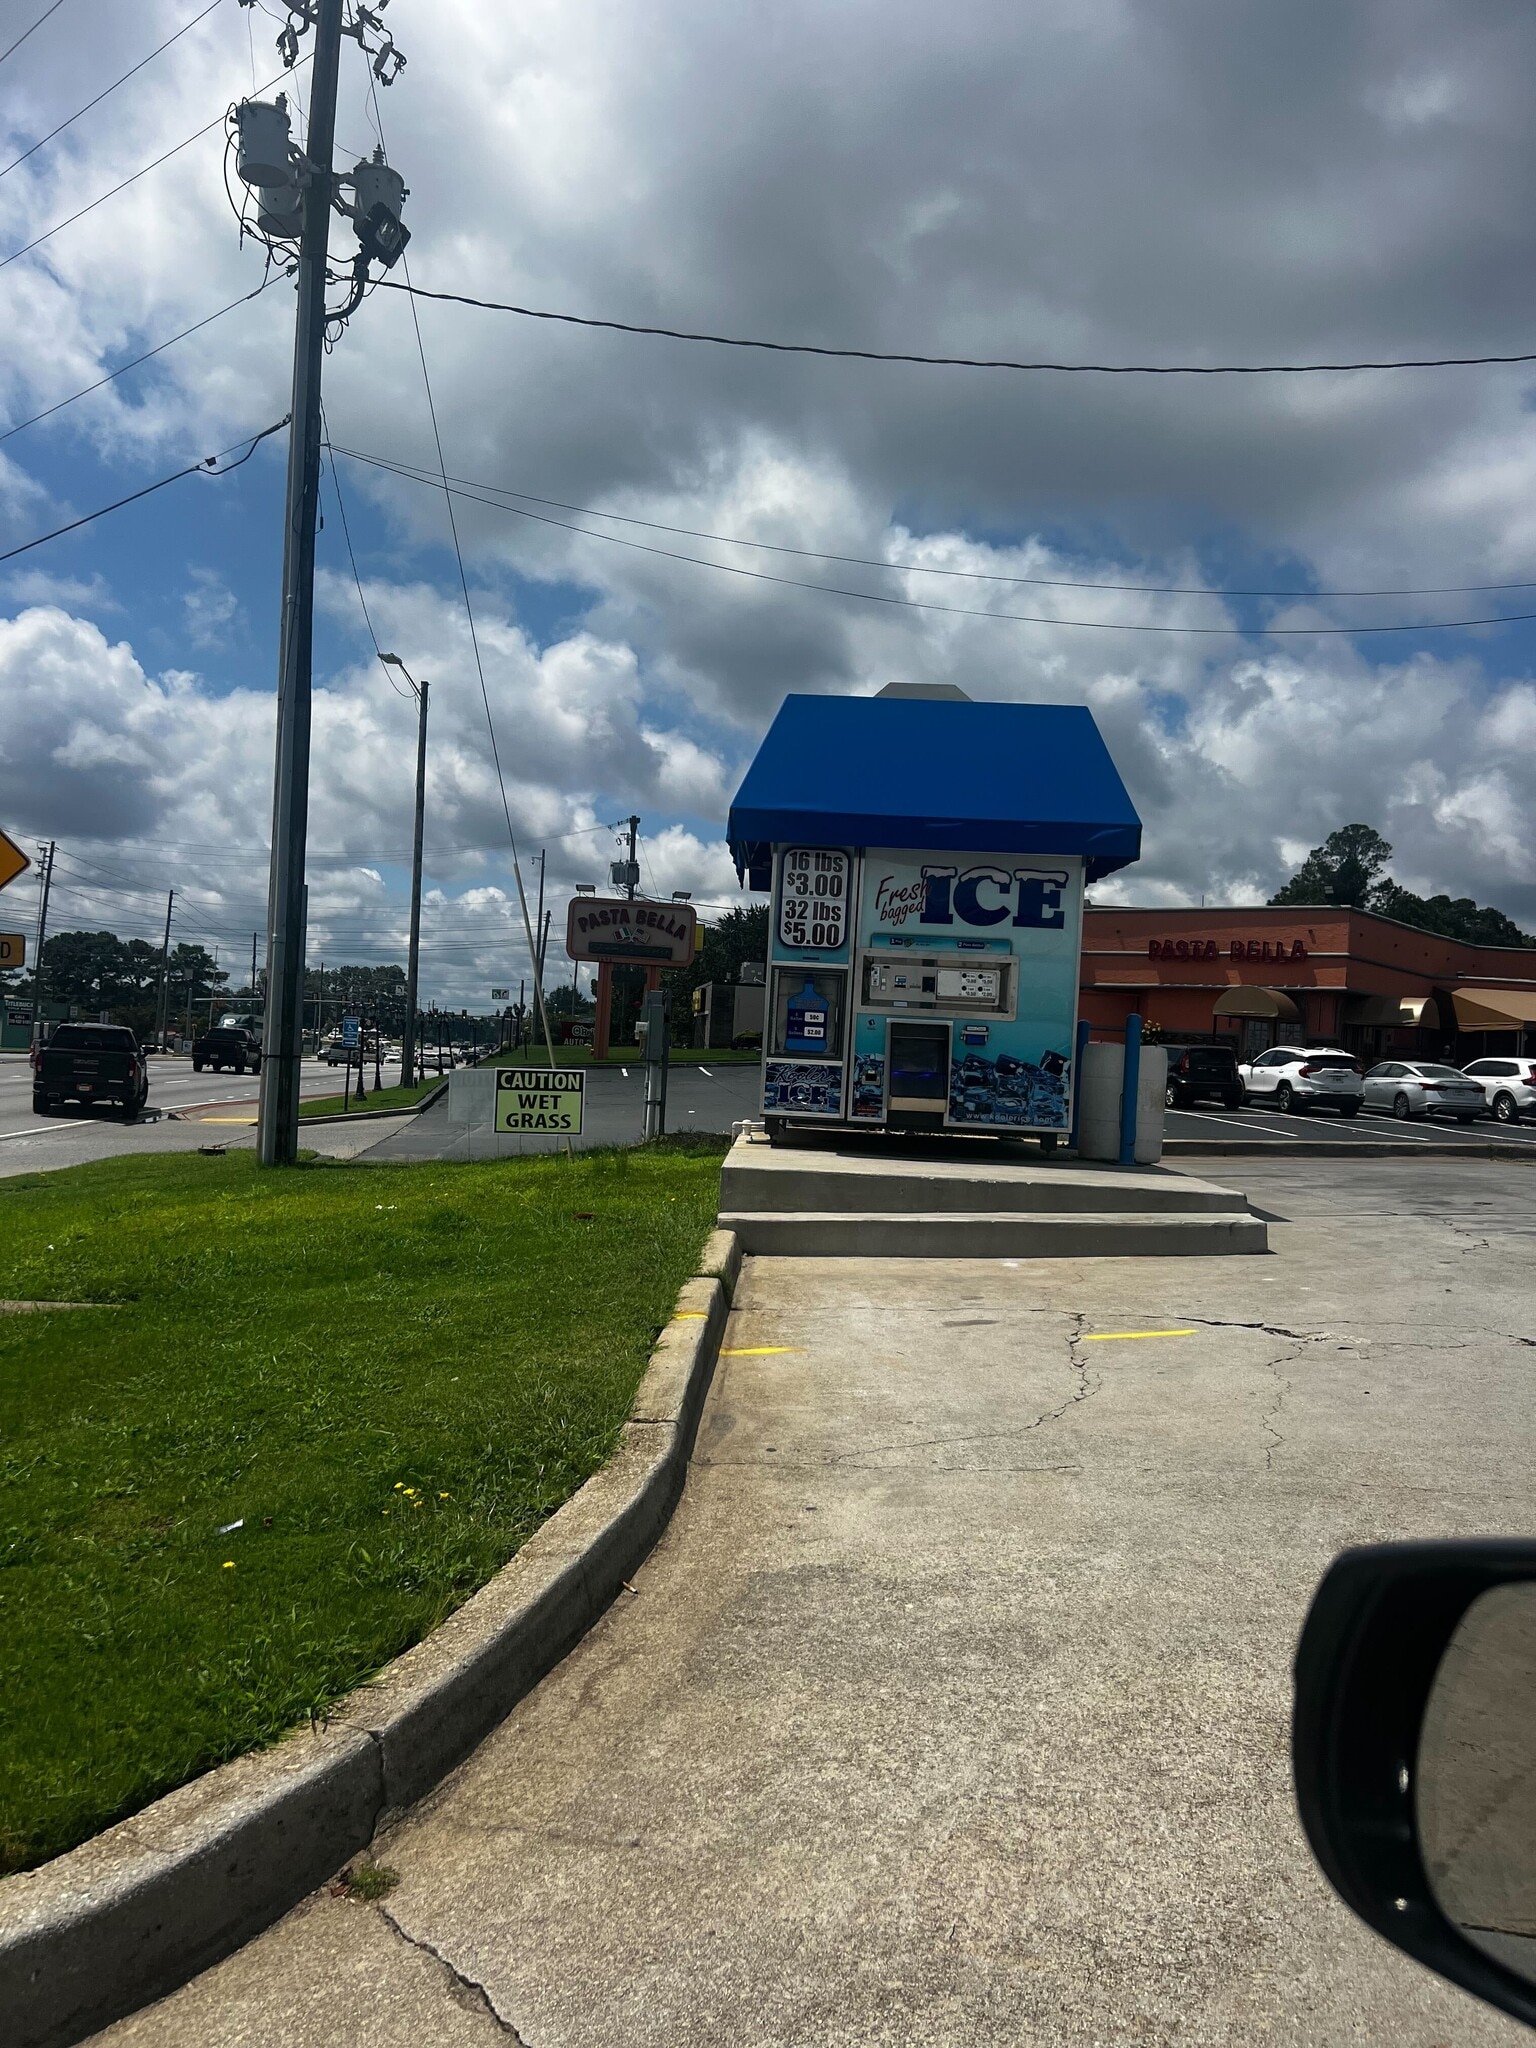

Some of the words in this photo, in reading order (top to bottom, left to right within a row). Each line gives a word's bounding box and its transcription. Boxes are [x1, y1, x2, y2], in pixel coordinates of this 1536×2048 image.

[790, 852, 810, 871] 16
[814, 852, 844, 873] lbs
[787, 872, 843, 897] $3.00
[875, 869, 932, 909] Fresh
[920, 865, 1069, 929] ICE
[785, 900, 809, 920] 32
[813, 901, 842, 922] lbs
[880, 896, 925, 926] bagged
[577, 908, 630, 933] PASTA
[635, 909, 687, 940] BELLA
[784, 920, 840, 946] $5.00
[1148, 939, 1218, 962] PASTA
[1230, 939, 1308, 964] BELLA
[564, 1038, 584, 1046] AUTO
[500, 1072, 580, 1090] CAUTION
[777, 1081, 829, 1105] ICE
[518, 1094, 561, 1110] WET
[506, 1113, 571, 1129] GRASS
